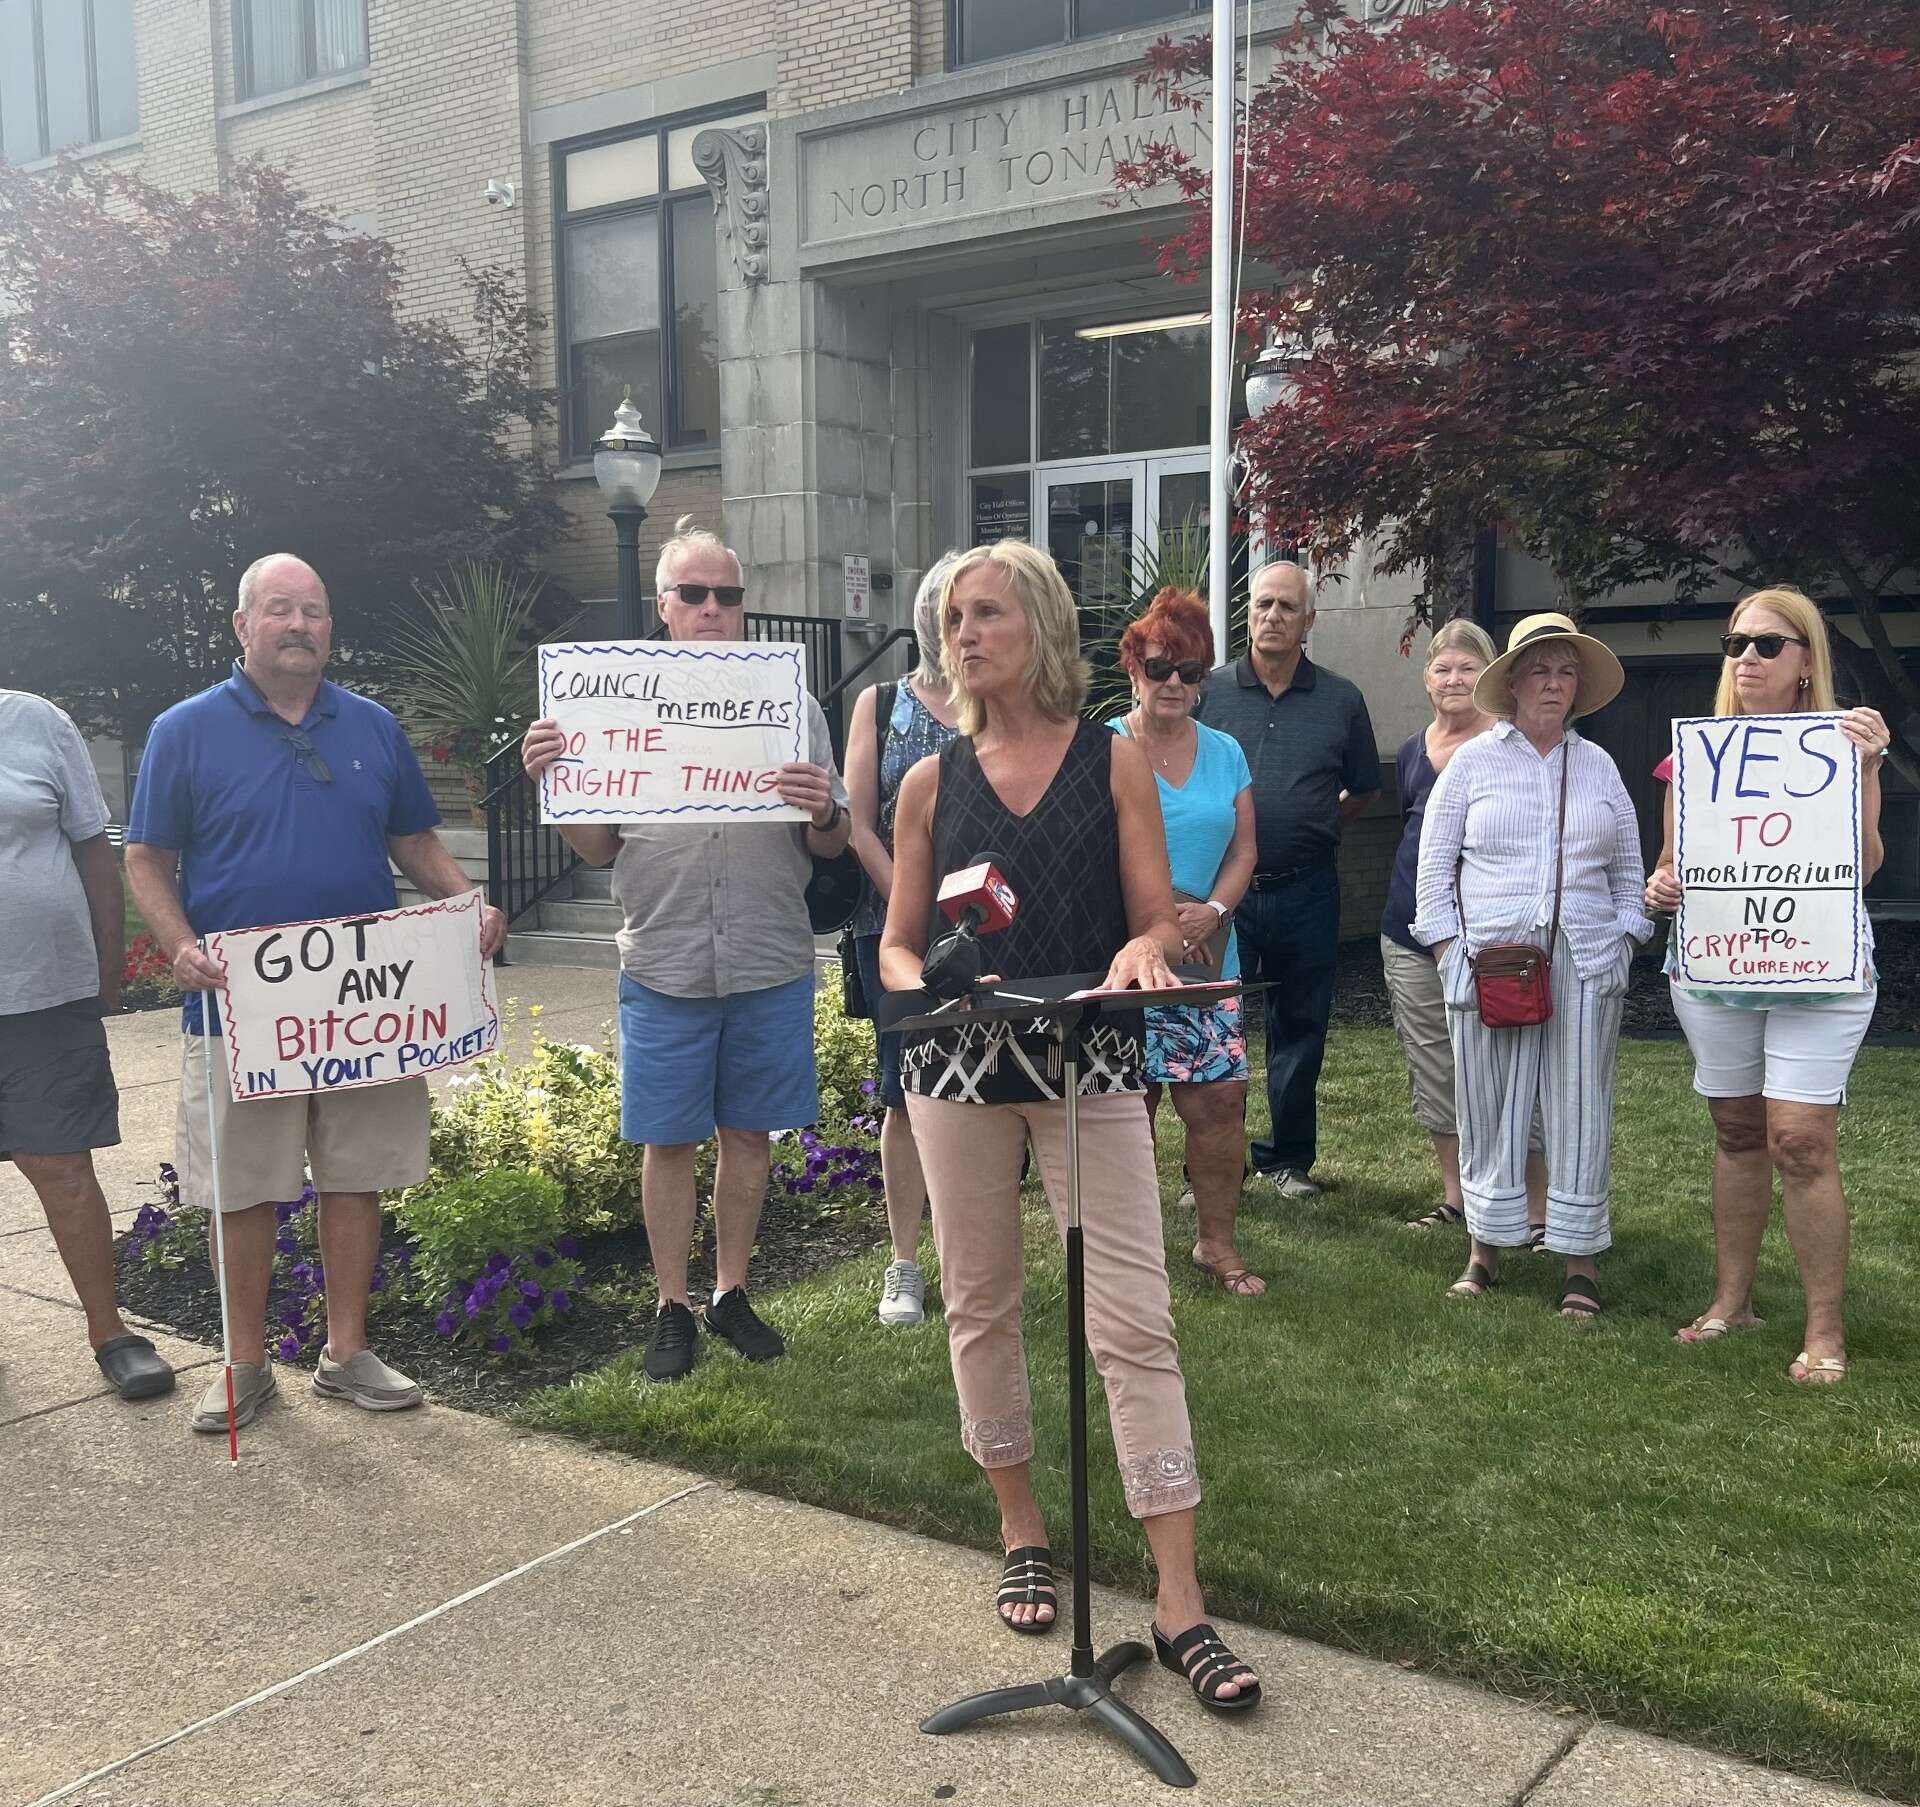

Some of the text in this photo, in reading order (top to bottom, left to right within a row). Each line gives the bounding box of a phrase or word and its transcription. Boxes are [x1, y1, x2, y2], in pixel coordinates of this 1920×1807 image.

[913, 78, 1182, 162] CITY HALL
[831, 121, 1212, 225] NORTH TONAWAN
[551, 671, 668, 699] COUNCIL
[602, 728, 667, 752] THE
[1697, 724, 1838, 803] YES
[552, 765, 780, 797] RIGHT THING
[1730, 812, 1792, 855] TO
[1744, 896, 1796, 925] NO
[254, 918, 379, 983] GOT
[1750, 928, 1788, 944] TO
[338, 960, 414, 1005] ANY
[1728, 958, 1829, 976] CURRENCY
[247, 1068, 276, 1093] IN
